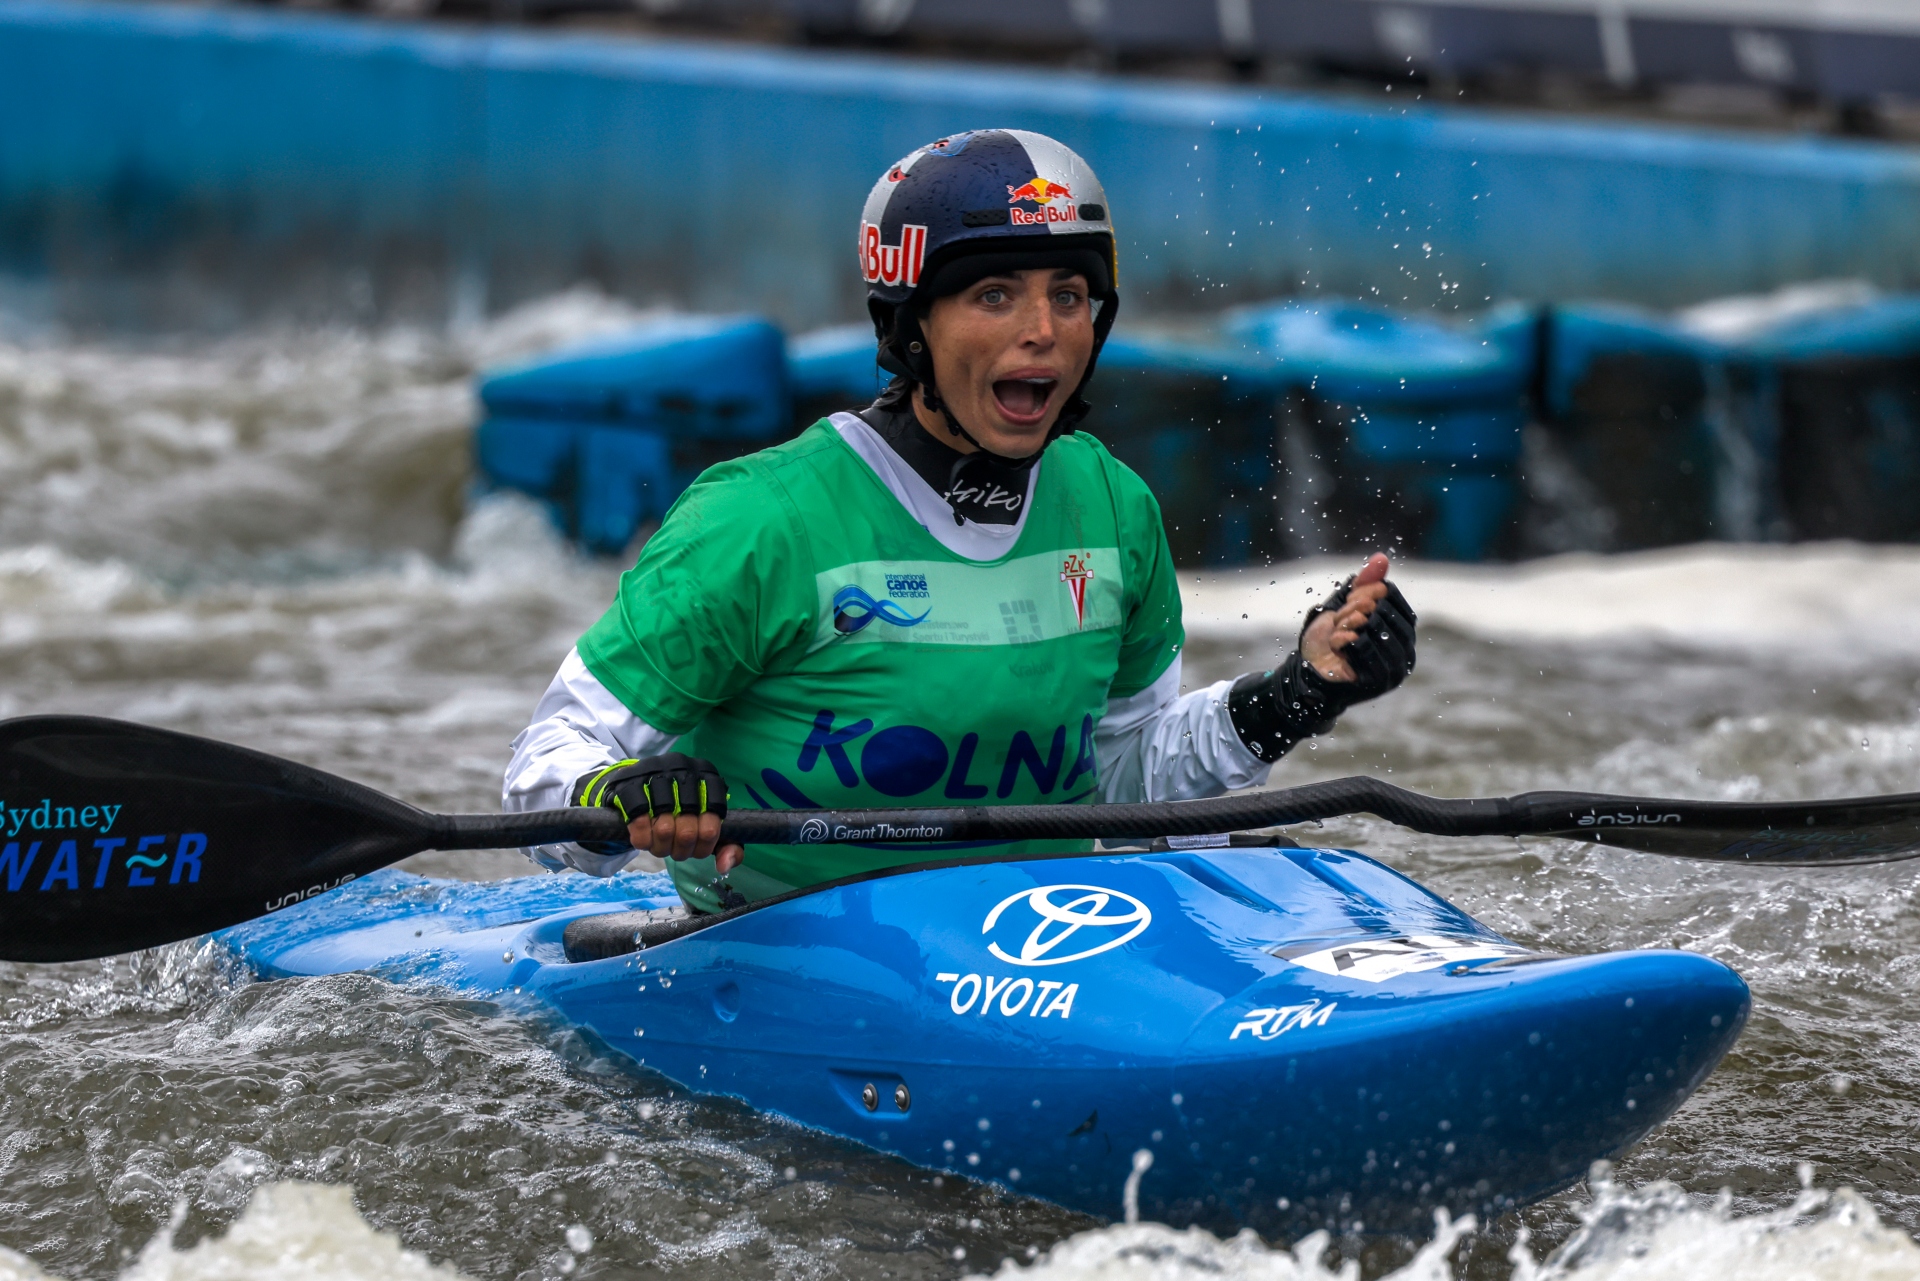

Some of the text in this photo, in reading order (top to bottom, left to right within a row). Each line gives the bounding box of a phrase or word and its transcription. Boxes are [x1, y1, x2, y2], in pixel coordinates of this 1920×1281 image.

[1010, 204, 1077, 225] Red Bull
[867, 223, 928, 288] Bull
[886, 580, 928, 591] canoe
[888, 590, 931, 599] federation
[796, 709, 1098, 800] KOLNA
[833, 823, 944, 840] Grant Thornton
[0, 832, 208, 892] WATER
[1229, 998, 1338, 1041] RTM
